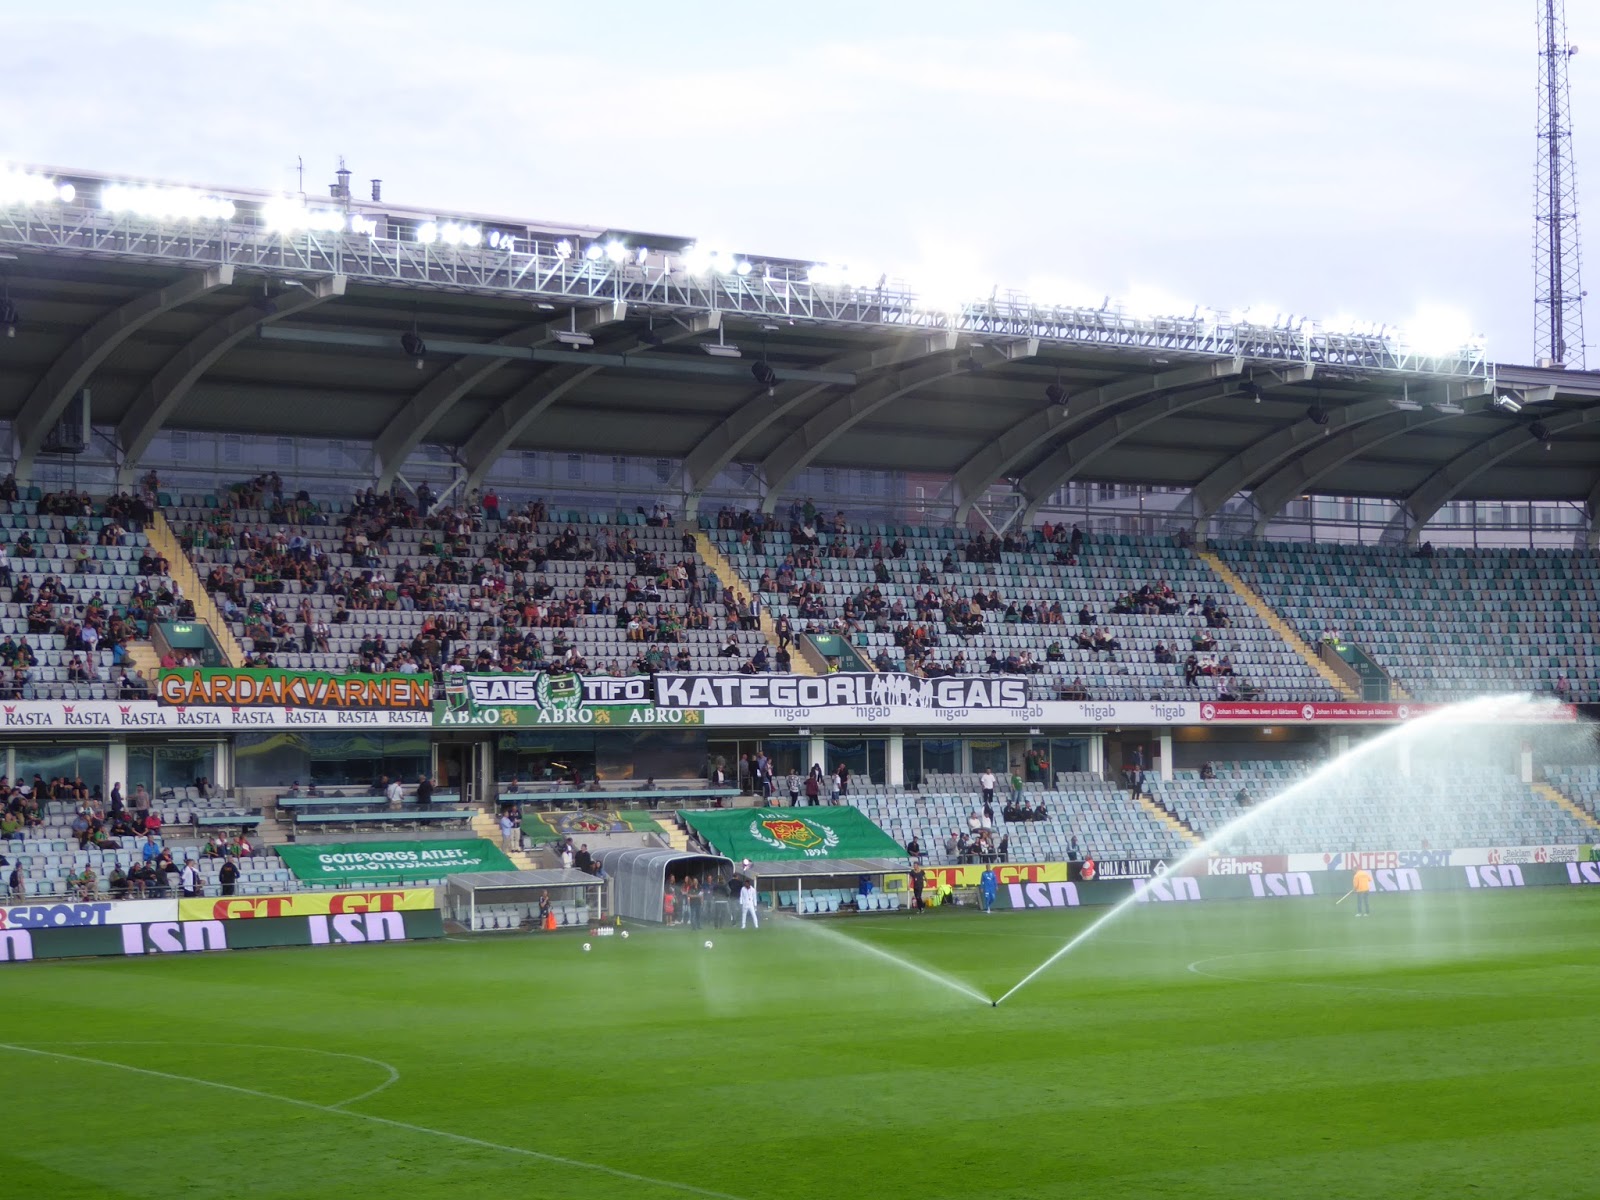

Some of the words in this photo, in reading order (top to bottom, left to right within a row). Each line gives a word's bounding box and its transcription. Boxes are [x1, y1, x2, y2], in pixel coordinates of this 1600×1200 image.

[161, 669, 429, 706] GÅRDAKVARNEN
[470, 681, 535, 700] GAIS
[584, 681, 644, 699] TIFO
[657, 677, 868, 706] KATEGORI
[938, 680, 1026, 708] GAIS
[6, 712, 52, 725] RASTA
[64, 712, 110, 725] RASTA
[121, 712, 166, 725] RASTA
[177, 712, 221, 724] RASTA
[232, 711, 275, 724] RASTA
[285, 711, 327, 723] RASTA
[337, 711, 378, 723] RASTA
[388, 711, 428, 723] RASTA
[1085, 704, 1116, 721] higab
[1155, 704, 1186, 721] higab
[803, 848, 828, 856] 1894
[1552, 848, 1577, 856] Reklam
[1208, 858, 1263, 875] Kährs
[1345, 849, 1452, 870] INTERSPORT
[993, 865, 1045, 883] GT
[1121, 861, 1127, 874] &
[1128, 860, 1151, 874] MATT
[213, 896, 293, 919] GT
[329, 892, 405, 914] GT
